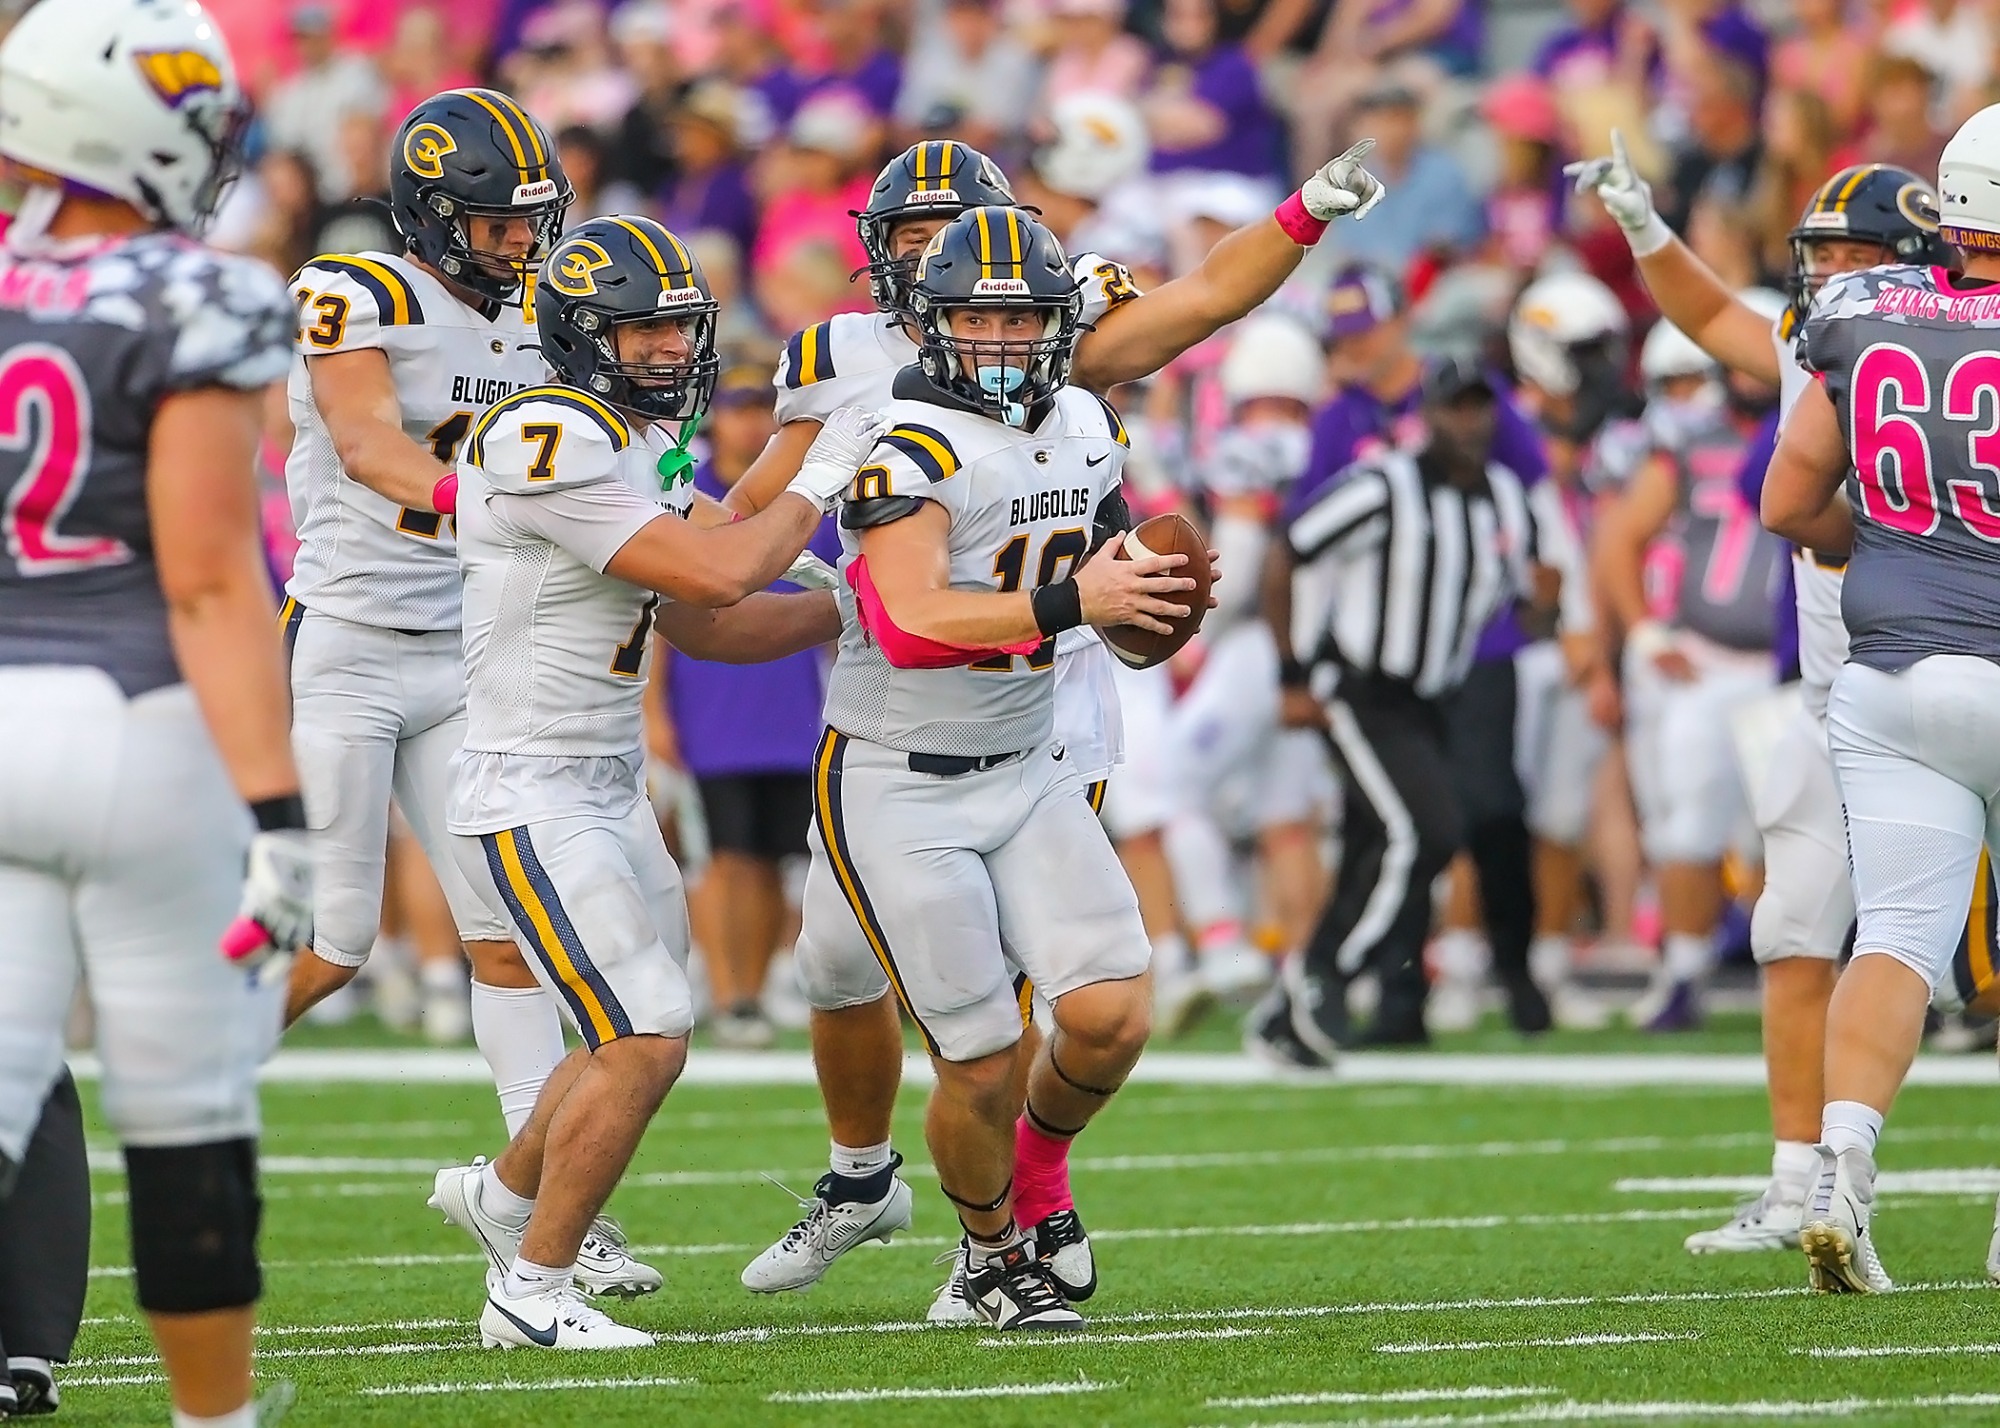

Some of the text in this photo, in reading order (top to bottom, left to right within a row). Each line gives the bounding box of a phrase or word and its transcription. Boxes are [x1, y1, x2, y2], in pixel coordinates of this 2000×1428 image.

[520, 183, 553, 198] Riddell
[911, 192, 953, 202] Riddell
[666, 290, 700, 303] Riddell
[981, 281, 1023, 292] Riddell
[1092, 263, 1140, 310] 2
[1873, 287, 1943, 319] DENNIS
[521, 422, 563, 482] 7
[1850, 341, 2000, 544] 63
[1009, 488, 1090, 527] BLUGOLDS
